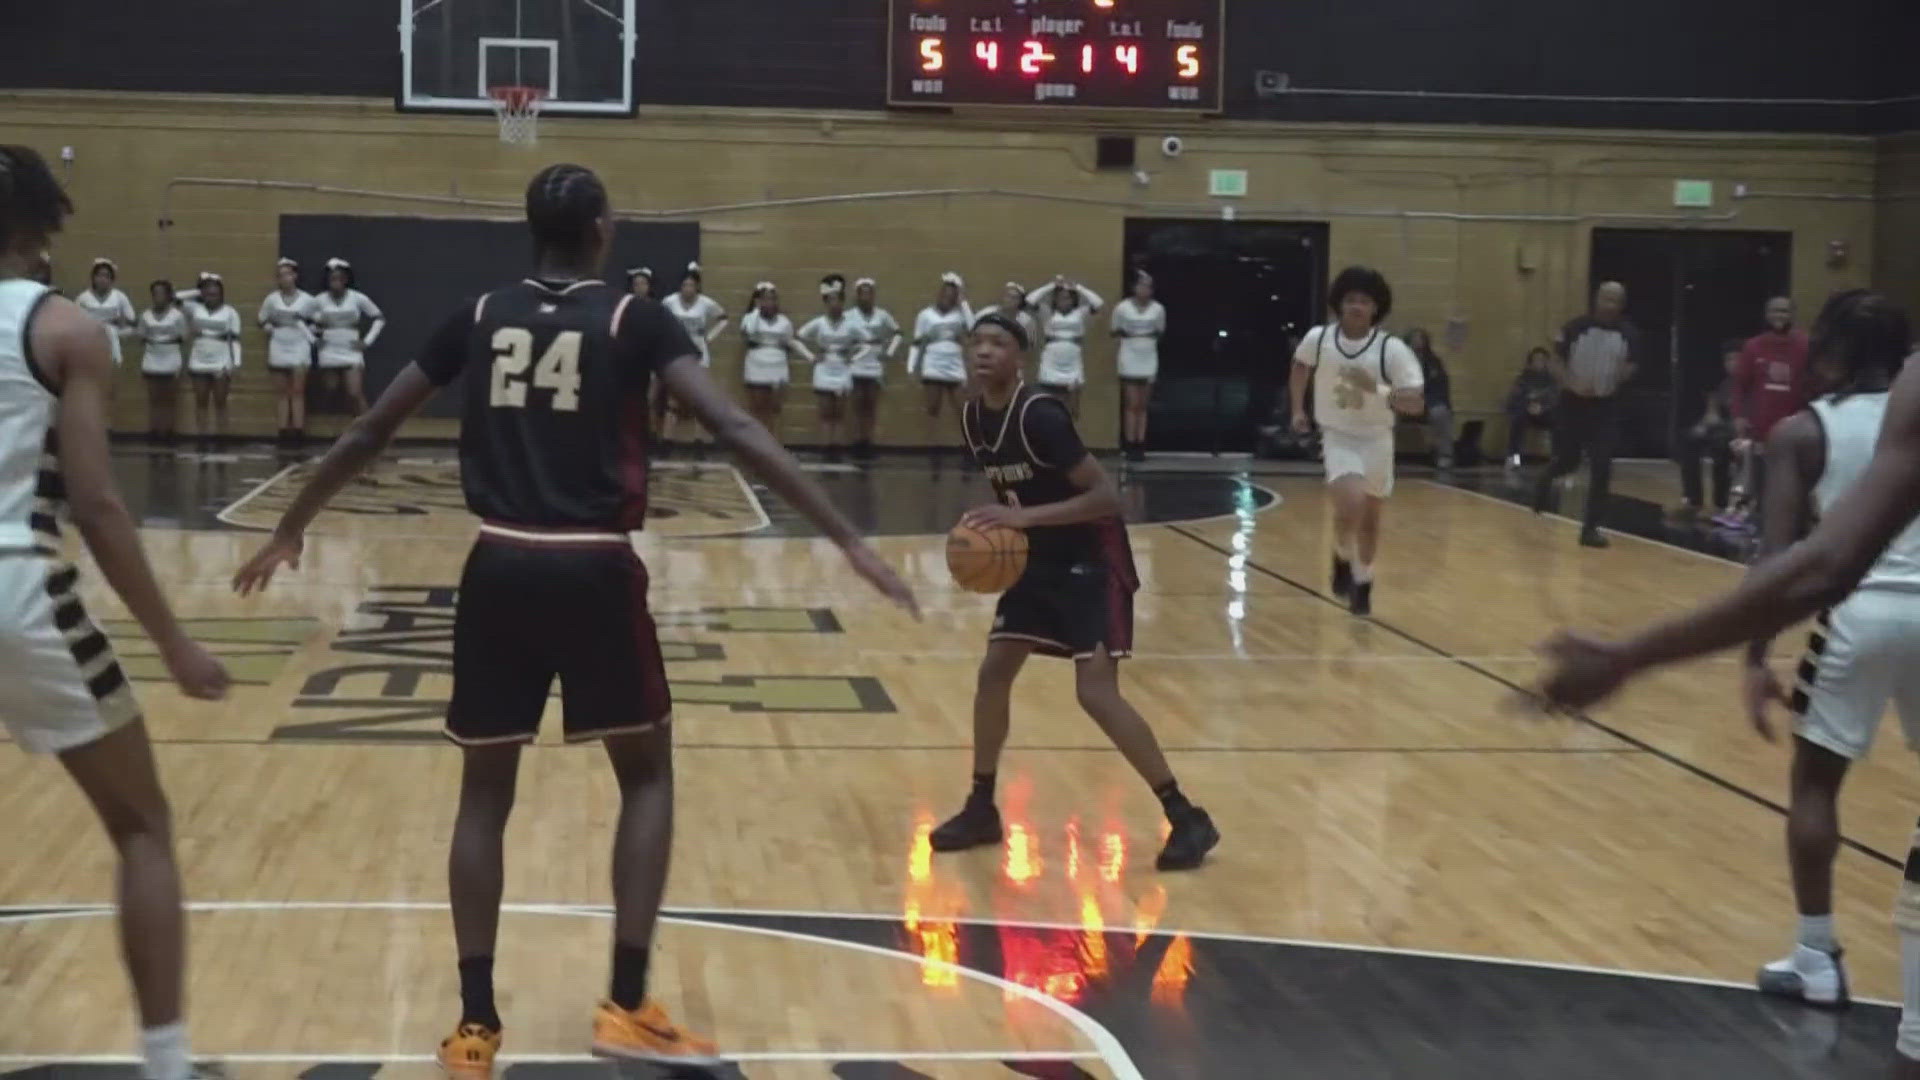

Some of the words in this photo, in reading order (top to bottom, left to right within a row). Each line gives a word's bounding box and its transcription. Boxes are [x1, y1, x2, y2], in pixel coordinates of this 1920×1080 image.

[1032, 15, 1083, 37] player
[921, 38, 943, 70] 5
[976, 41, 998, 70] 4
[1115, 45, 1138, 74] 4
[1177, 44, 1199, 77] 5
[490, 326, 584, 412] 24
